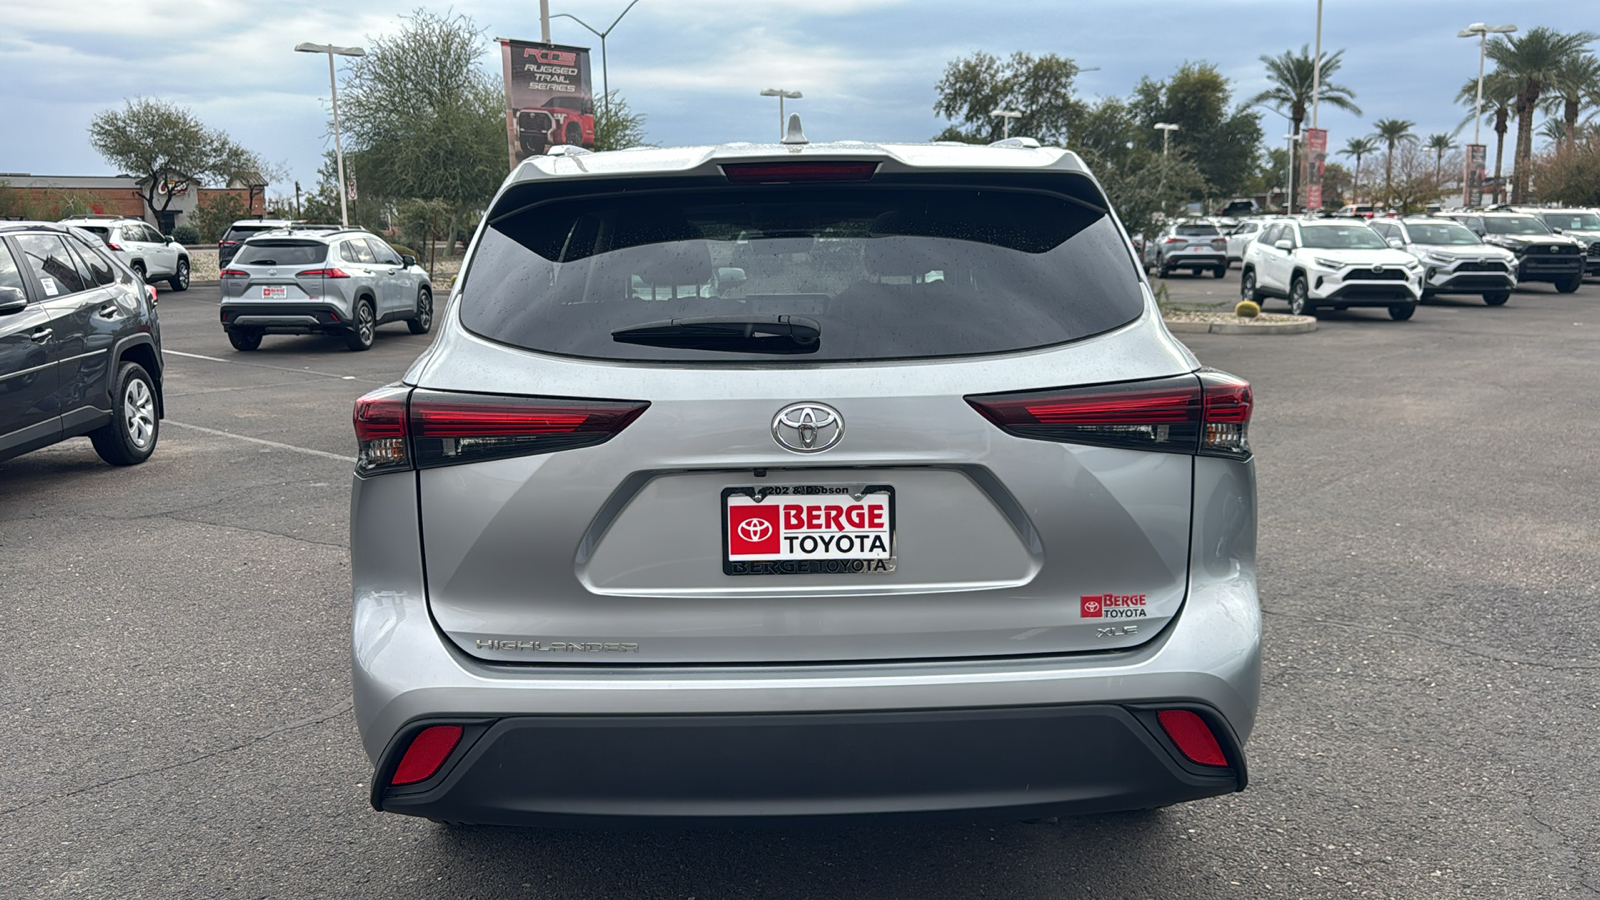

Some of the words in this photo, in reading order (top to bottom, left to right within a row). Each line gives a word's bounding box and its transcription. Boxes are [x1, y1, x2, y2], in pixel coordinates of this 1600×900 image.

[524, 64, 578, 76] RUGGED
[534, 73, 570, 83] TRAIL
[529, 82, 576, 93] SERIES
[768, 486, 789, 495] 202
[793, 486, 801, 495] &
[806, 485, 849, 495] Dobson
[783, 504, 885, 532] BERGE
[784, 534, 887, 554] TOYOTA
[732, 560, 810, 575] BERGE
[817, 559, 887, 574] TOYOTA
[1103, 593, 1147, 607] BERGE
[1104, 608, 1147, 618] TOYOTA
[1096, 625, 1138, 638] XLE
[476, 639, 639, 653] HIGHLANDER
